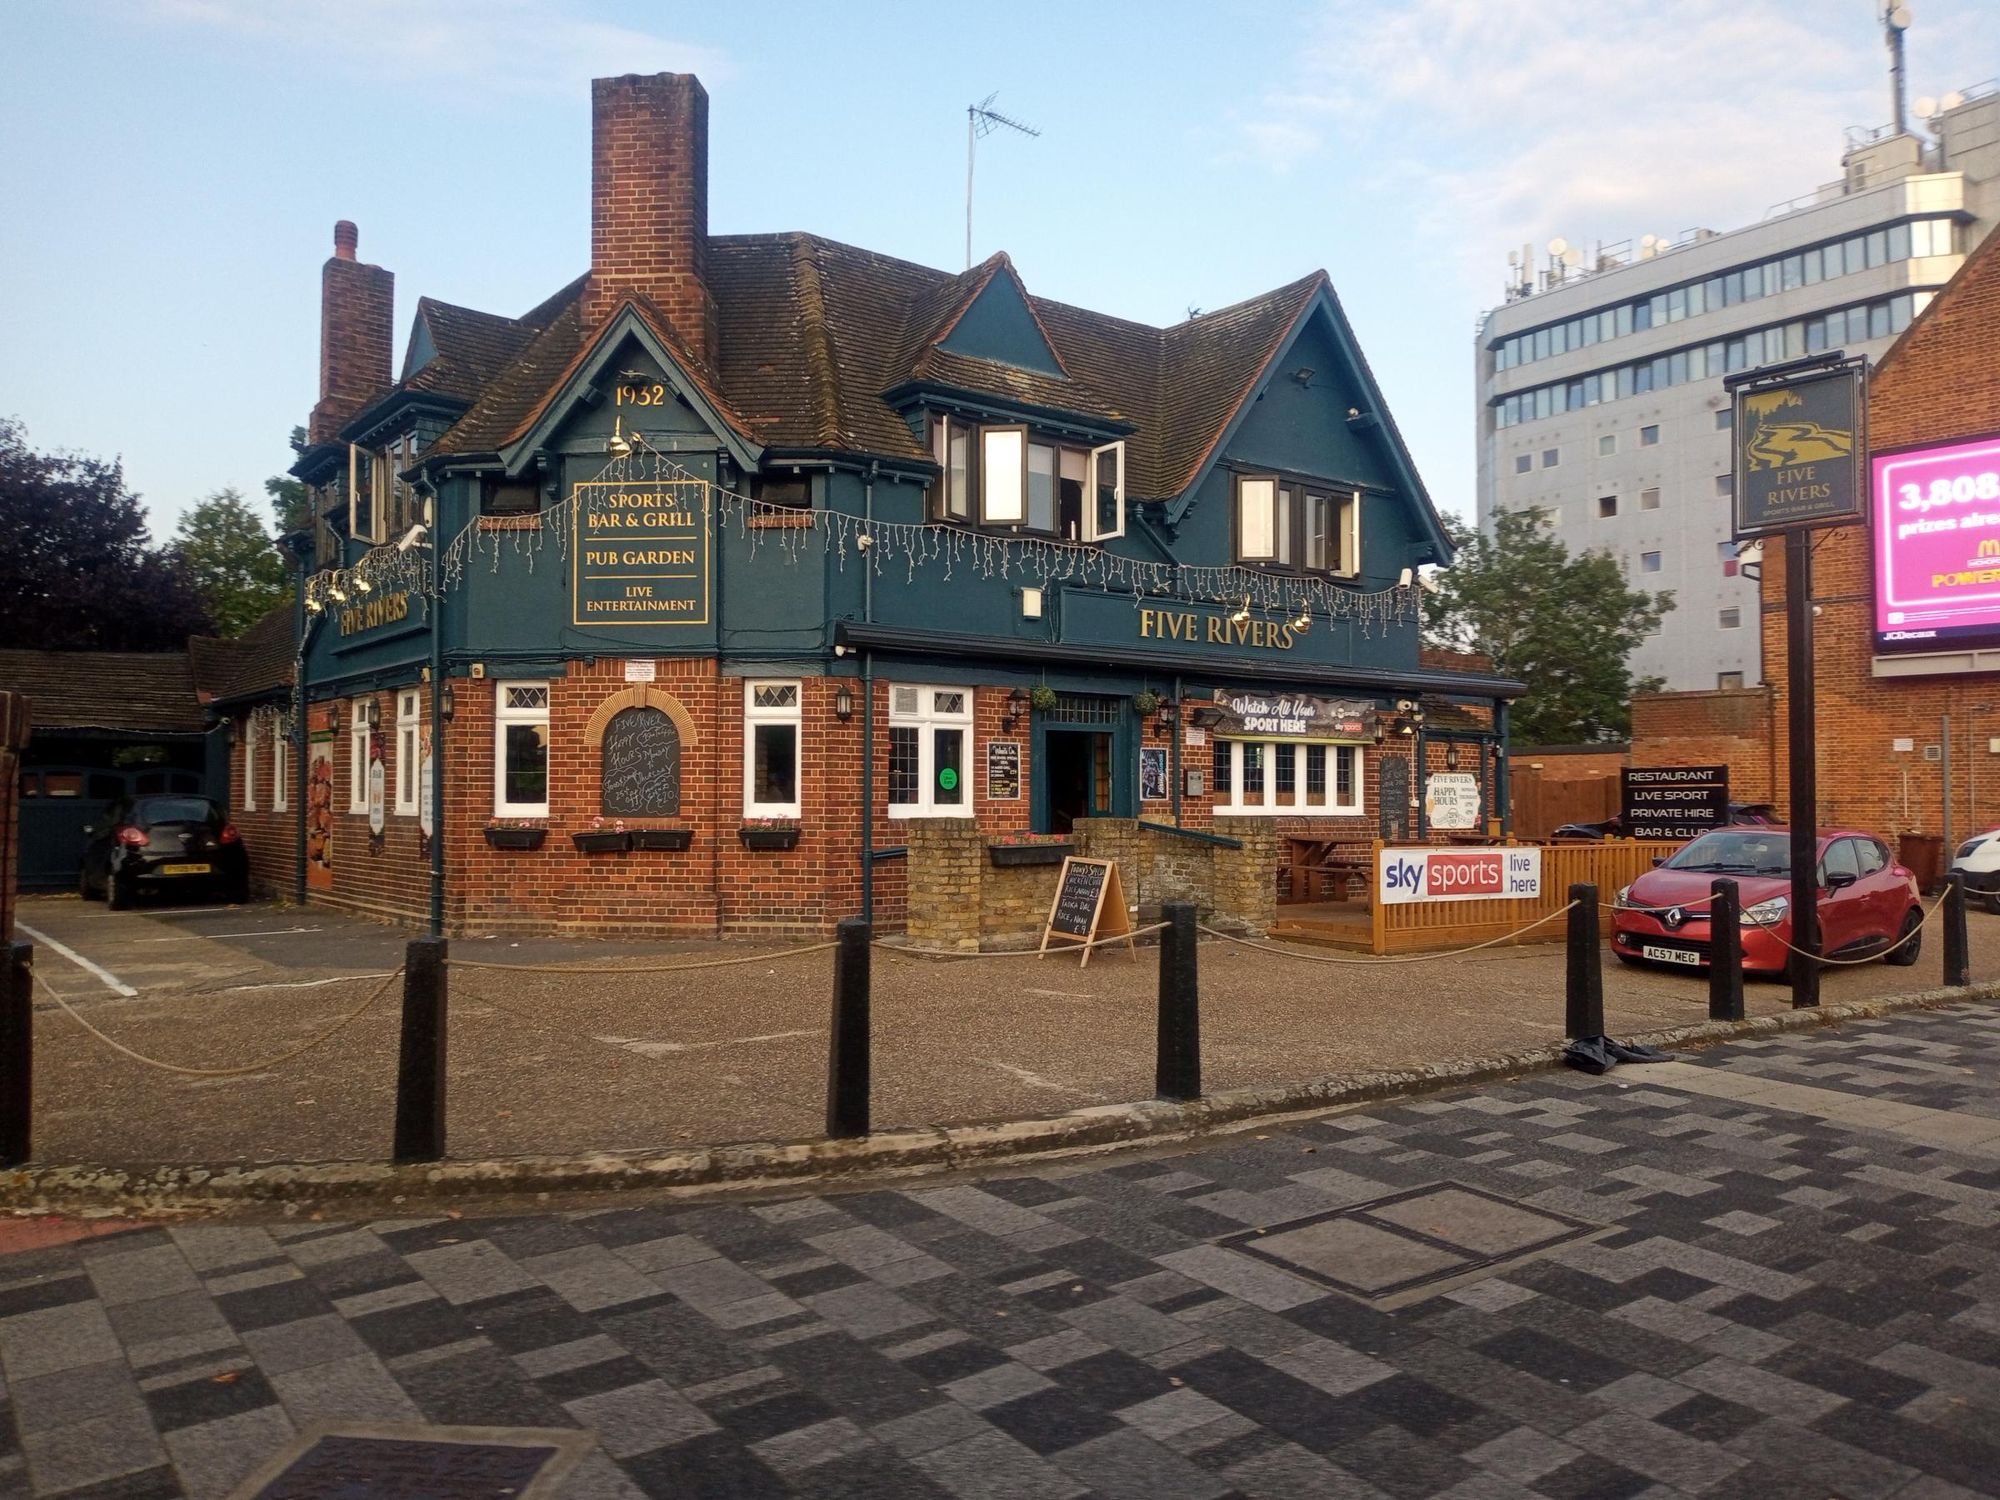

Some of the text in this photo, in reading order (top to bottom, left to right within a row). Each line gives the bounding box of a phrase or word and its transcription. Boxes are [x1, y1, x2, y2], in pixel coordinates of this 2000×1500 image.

[616, 385, 664, 406] 1932
[1777, 466, 1816, 484] FIVE
[609, 493, 674, 508] SPORTS
[1768, 483, 1831, 505] RIVERS
[588, 512, 695, 528] BAR & GRILL
[1898, 518, 1957, 540] prizes
[586, 551, 695, 566] PUB GARDEN
[626, 586, 653, 597] LIVE
[586, 600, 696, 612] ENTERTAINMENT
[1140, 609, 1294, 650] FIVE RIVERS
[1231, 695, 1269, 715] Watch
[1271, 700, 1291, 718] All
[1291, 700, 1316, 721] Your
[1244, 717, 1307, 733] SPORT HERE
[1628, 771, 1714, 781] RESTAURANT
[1433, 787, 1457, 796] HAPPY
[1634, 791, 1710, 800] LIVE SPORT
[1434, 796, 1458, 805] HOURS
[1630, 808, 1714, 818] PRIVATE HIRE
[1634, 827, 1662, 837] BAR
[1664, 828, 1673, 837] &
[1510, 854, 1531, 872] live
[1386, 858, 1499, 894] sky sports
[1510, 875, 1537, 893] here
[1648, 948, 1695, 963] AC57 MEG
